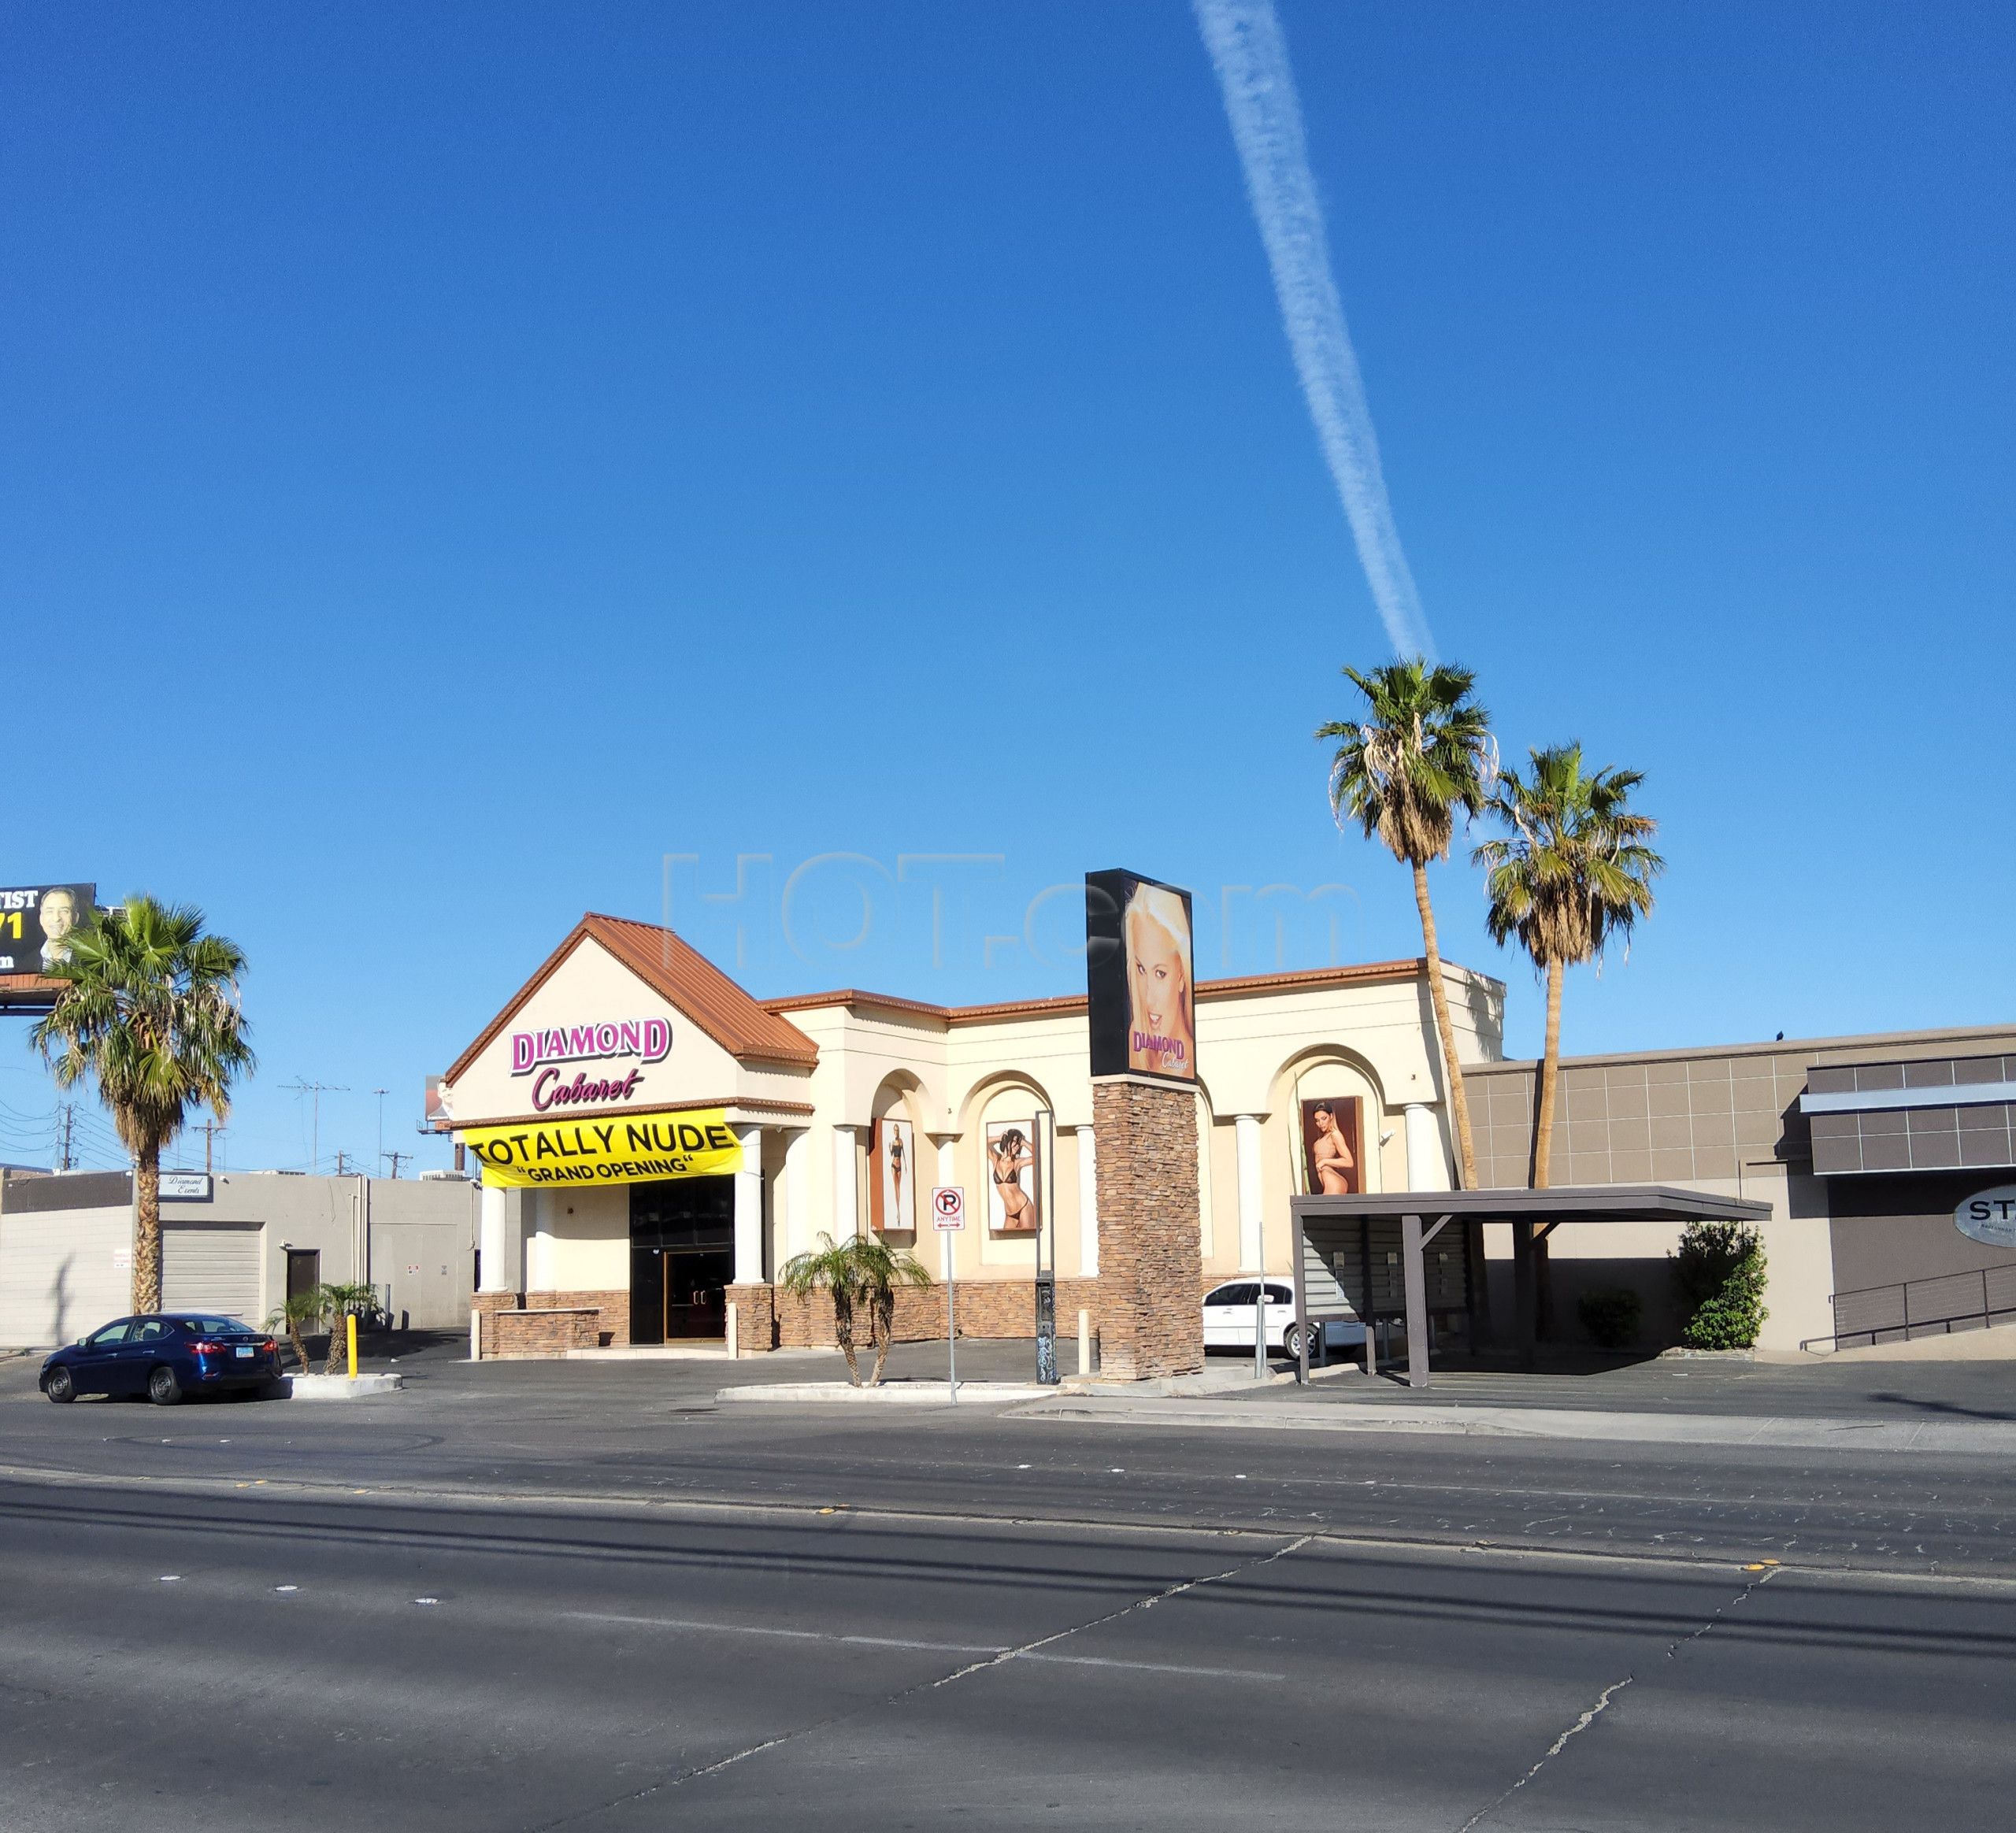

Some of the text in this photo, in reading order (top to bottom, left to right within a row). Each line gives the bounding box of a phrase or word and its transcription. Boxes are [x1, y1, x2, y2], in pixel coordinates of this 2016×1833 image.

[510, 1016, 672, 1076] DIAMOND
[1134, 1031, 1184, 1059] DIAMOND
[1162, 1052, 1189, 1069] Cabaret
[532, 1067, 645, 1112] Cabaret
[468, 1124, 735, 1165] TOTALLY NUDE
[168, 1176, 203, 1185] Diamond
[178, 1185, 199, 1194] Events
[1970, 1200, 2016, 1220] ST
